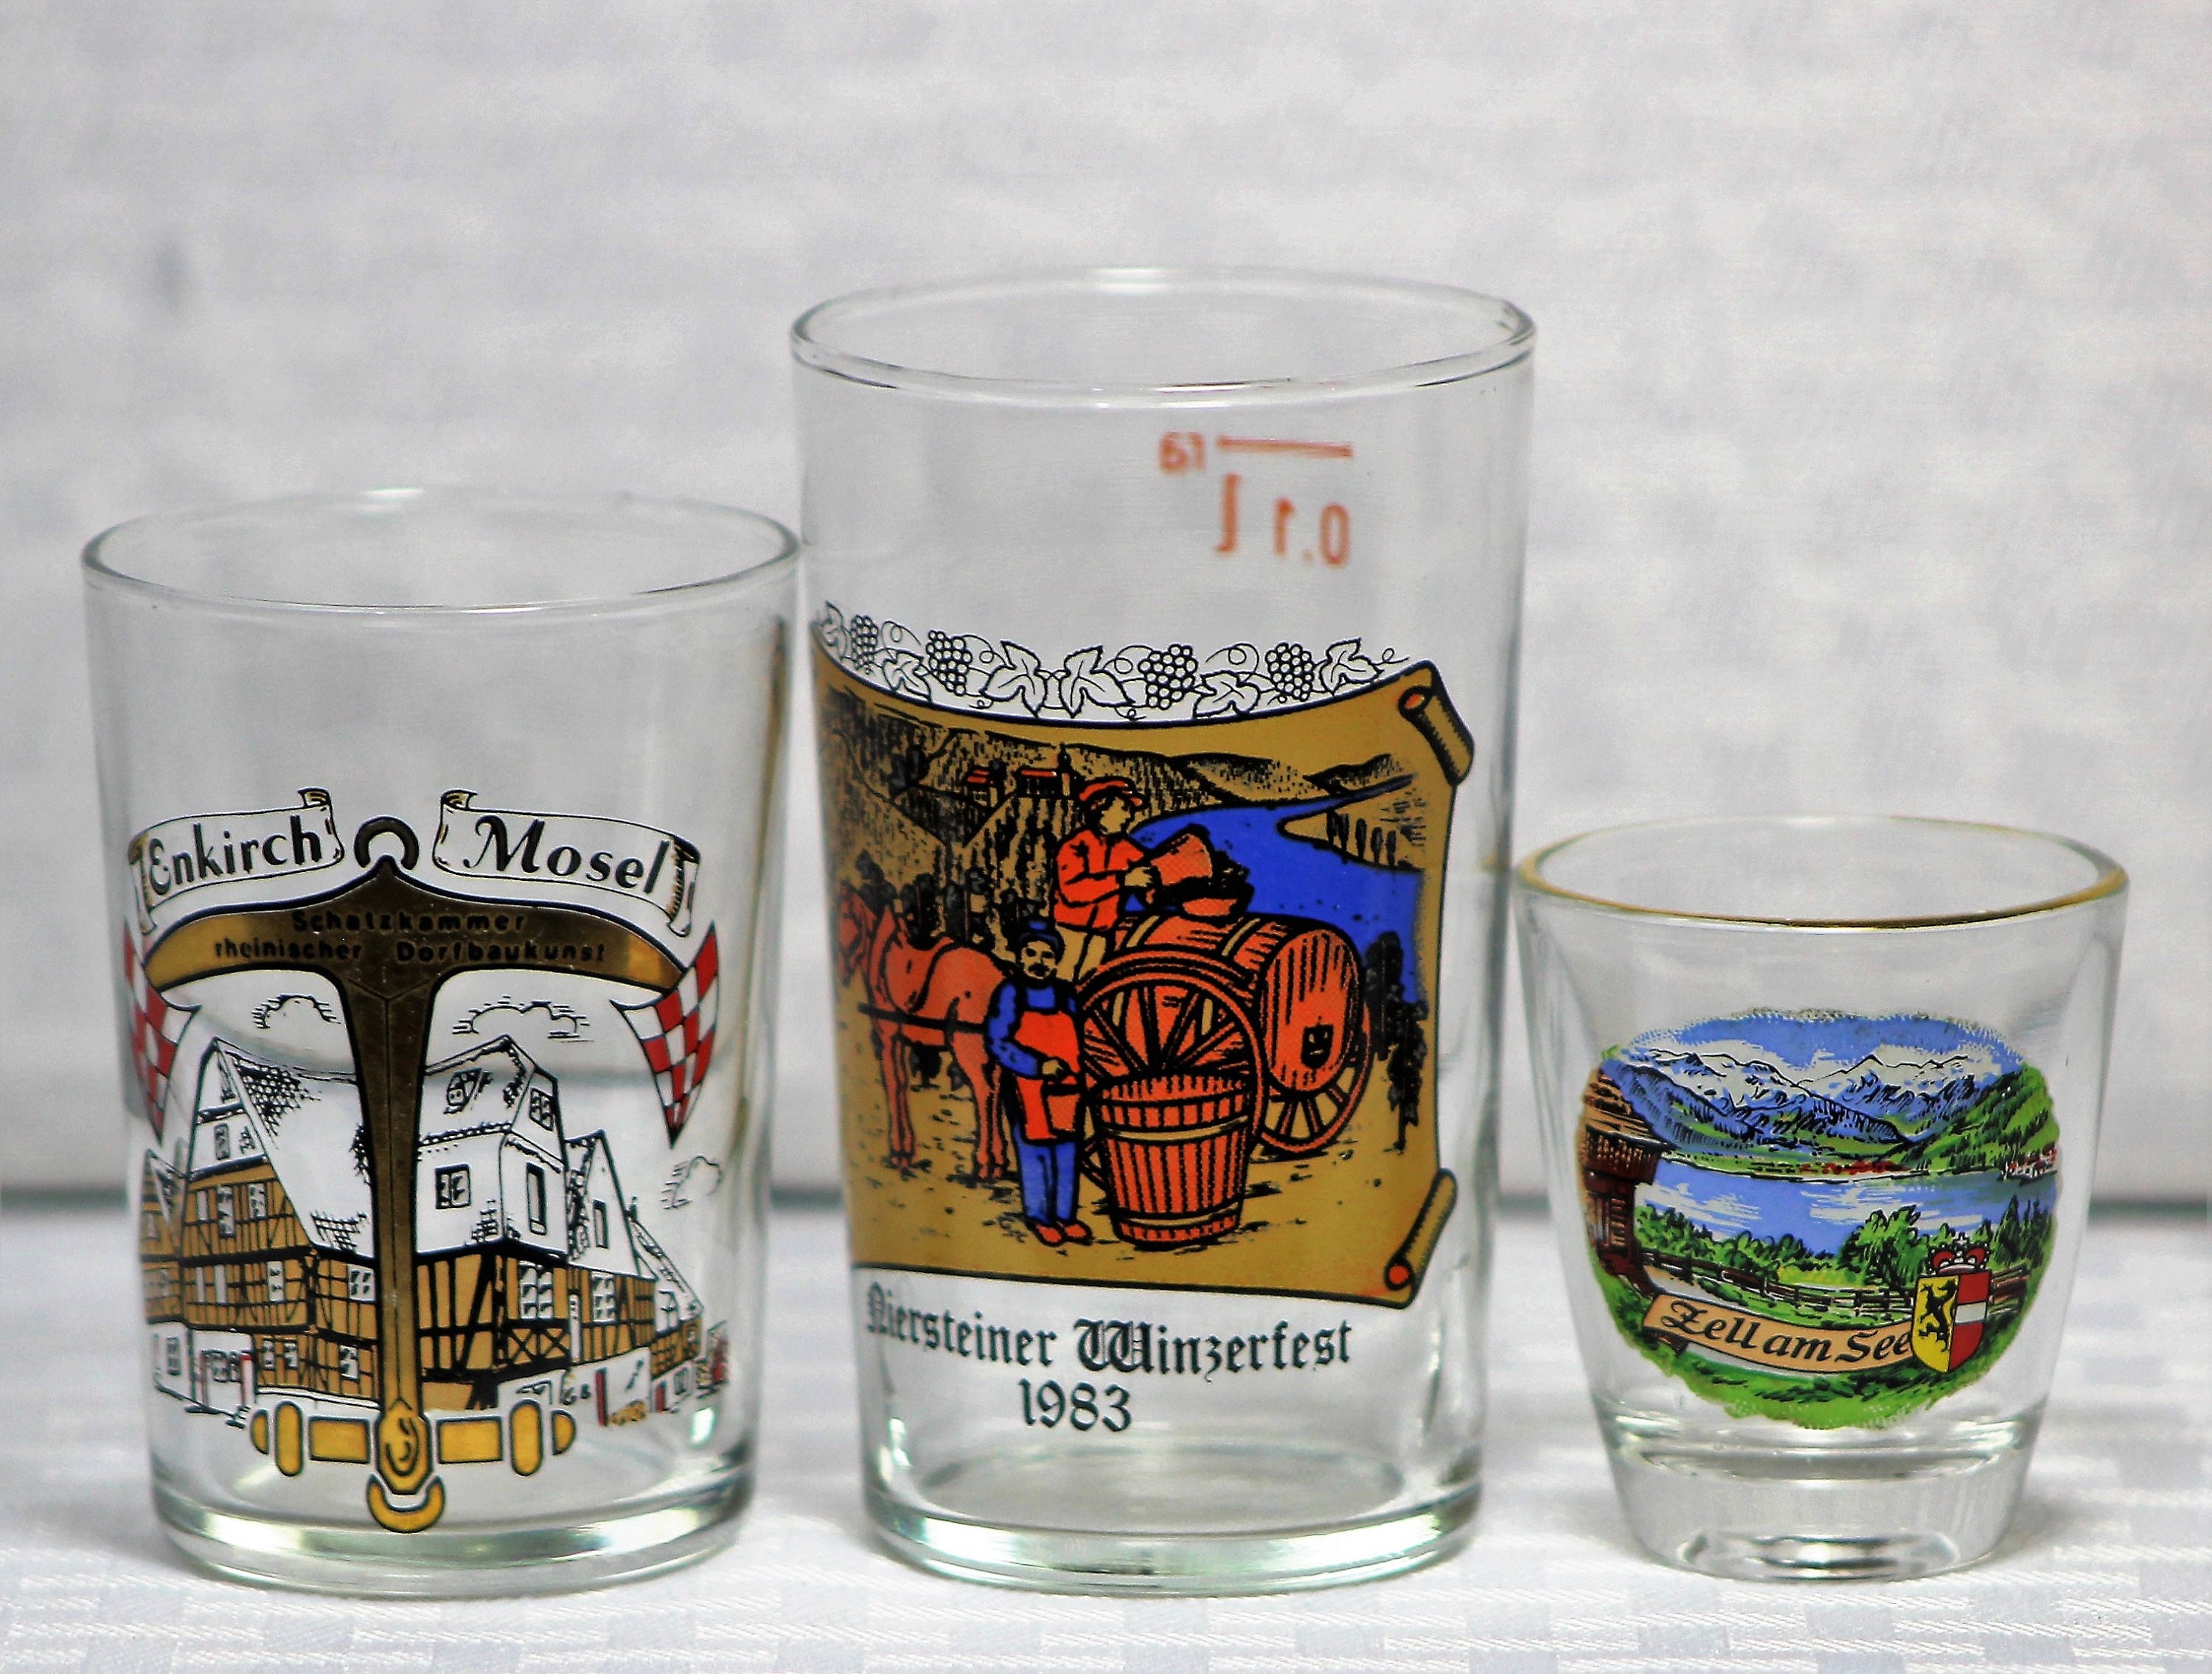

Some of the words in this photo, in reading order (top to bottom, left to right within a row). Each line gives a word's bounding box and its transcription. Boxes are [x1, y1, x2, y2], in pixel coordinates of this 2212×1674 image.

[149, 814, 323, 896] Enkirch
[463, 815, 671, 894] Mosel
[215, 937, 363, 960] rheinischer
[396, 940, 605, 962] Dorfbaukunst
[292, 909, 526, 933] Schatzkammer
[1074, 1316, 1352, 1382] Winzerfest
[1661, 1300, 1757, 1350] Zell
[1762, 1332, 1832, 1361] am
[1834, 1329, 1912, 1363] See
[1018, 1378, 1133, 1432] 1983
